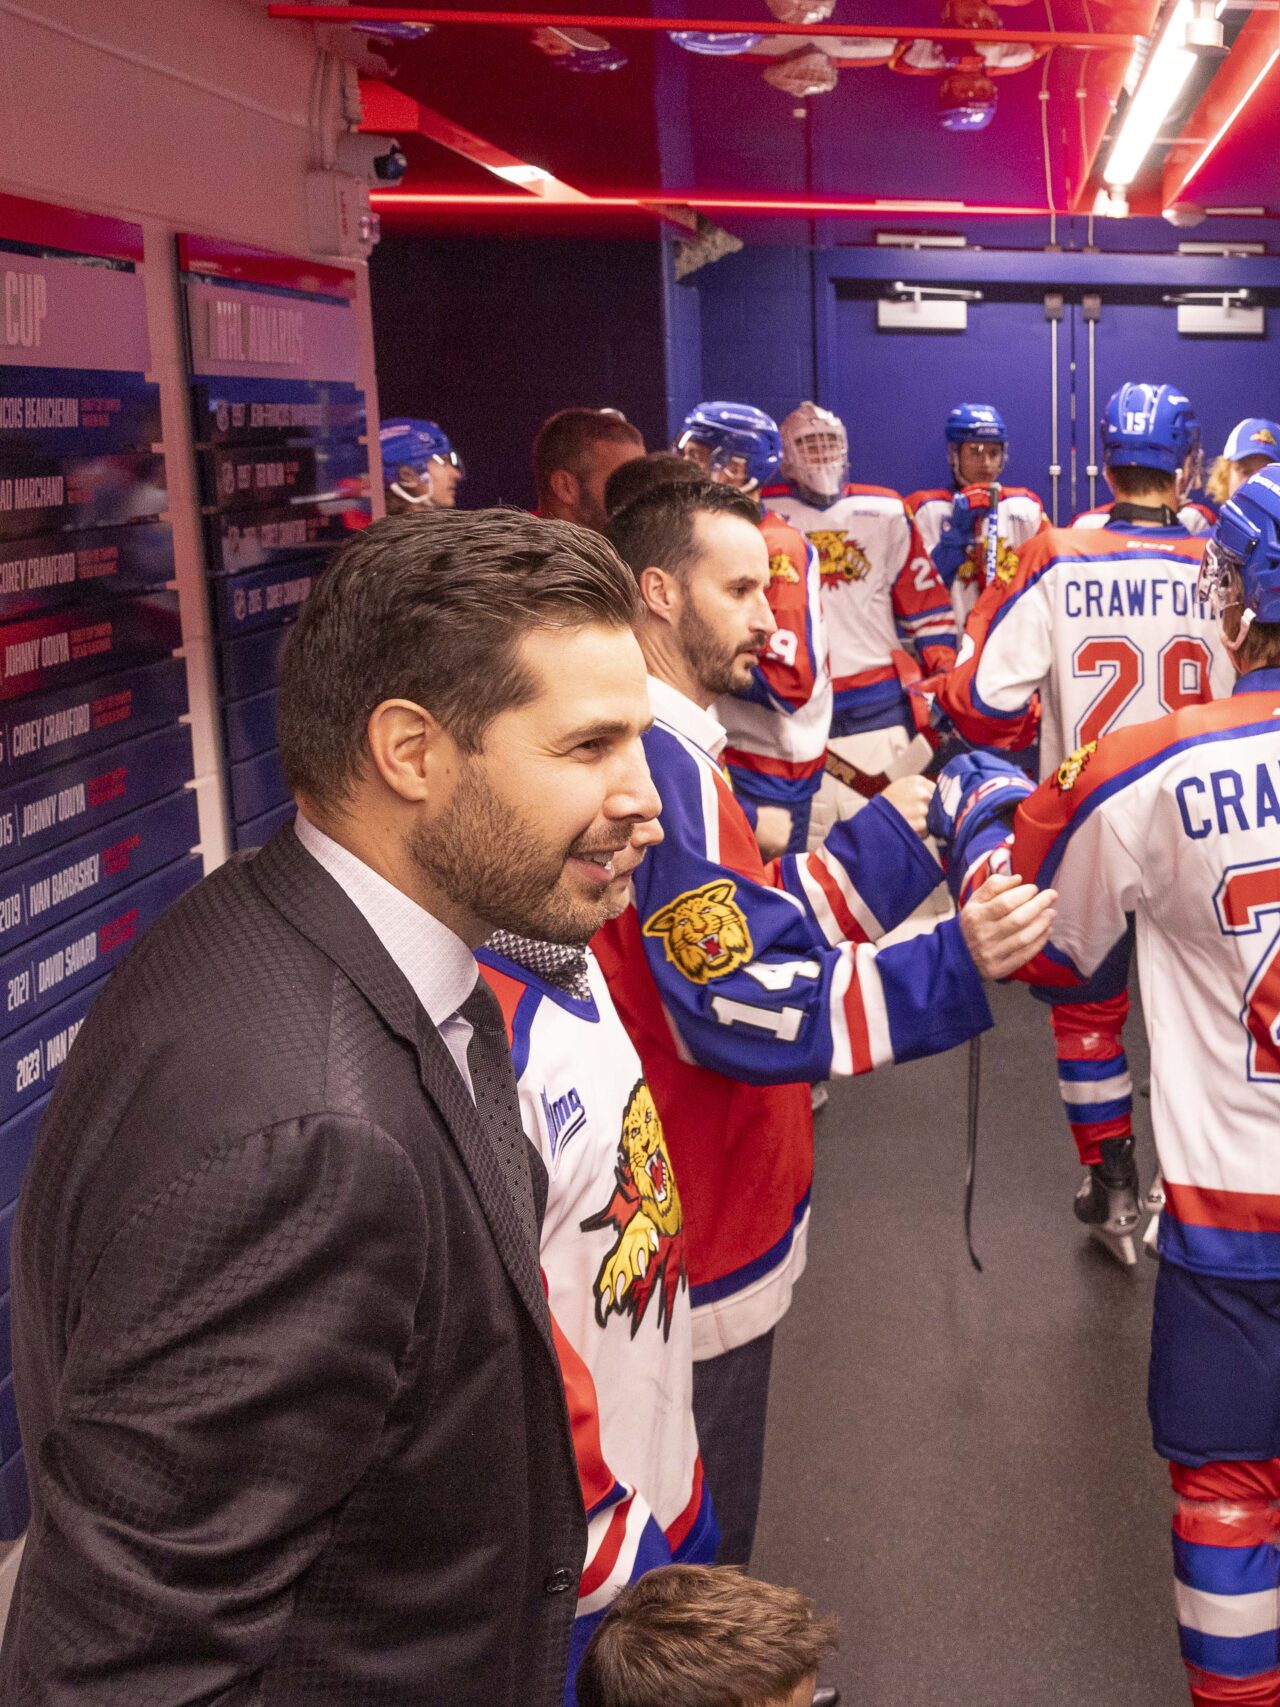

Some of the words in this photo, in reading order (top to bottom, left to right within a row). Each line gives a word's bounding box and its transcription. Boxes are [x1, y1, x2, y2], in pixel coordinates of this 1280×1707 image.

[6, 271, 47, 347] CUP
[1126, 411, 1147, 433] 15
[14, 476, 64, 509] MARCHAND
[28, 552, 75, 589] CRAWFORD
[1065, 578, 1222, 620] CRAWFO
[4, 638, 40, 678] JOHNNY
[41, 631, 70, 668] ODUYA
[13, 718, 42, 758] COREY
[43, 703, 90, 747] CRAWFORD
[22, 793, 57, 838] JOHNNY
[58, 782, 86, 821] ODUYA
[29, 877, 51, 918] IVAN
[51, 852, 100, 906] BARBASHEV
[8, 970, 29, 1012] 2021
[38, 950, 64, 994] DAVID
[65, 931, 97, 977] SAVARD
[16, 1048, 40, 1094] 2023
[47, 1029, 67, 1072] IVAN
